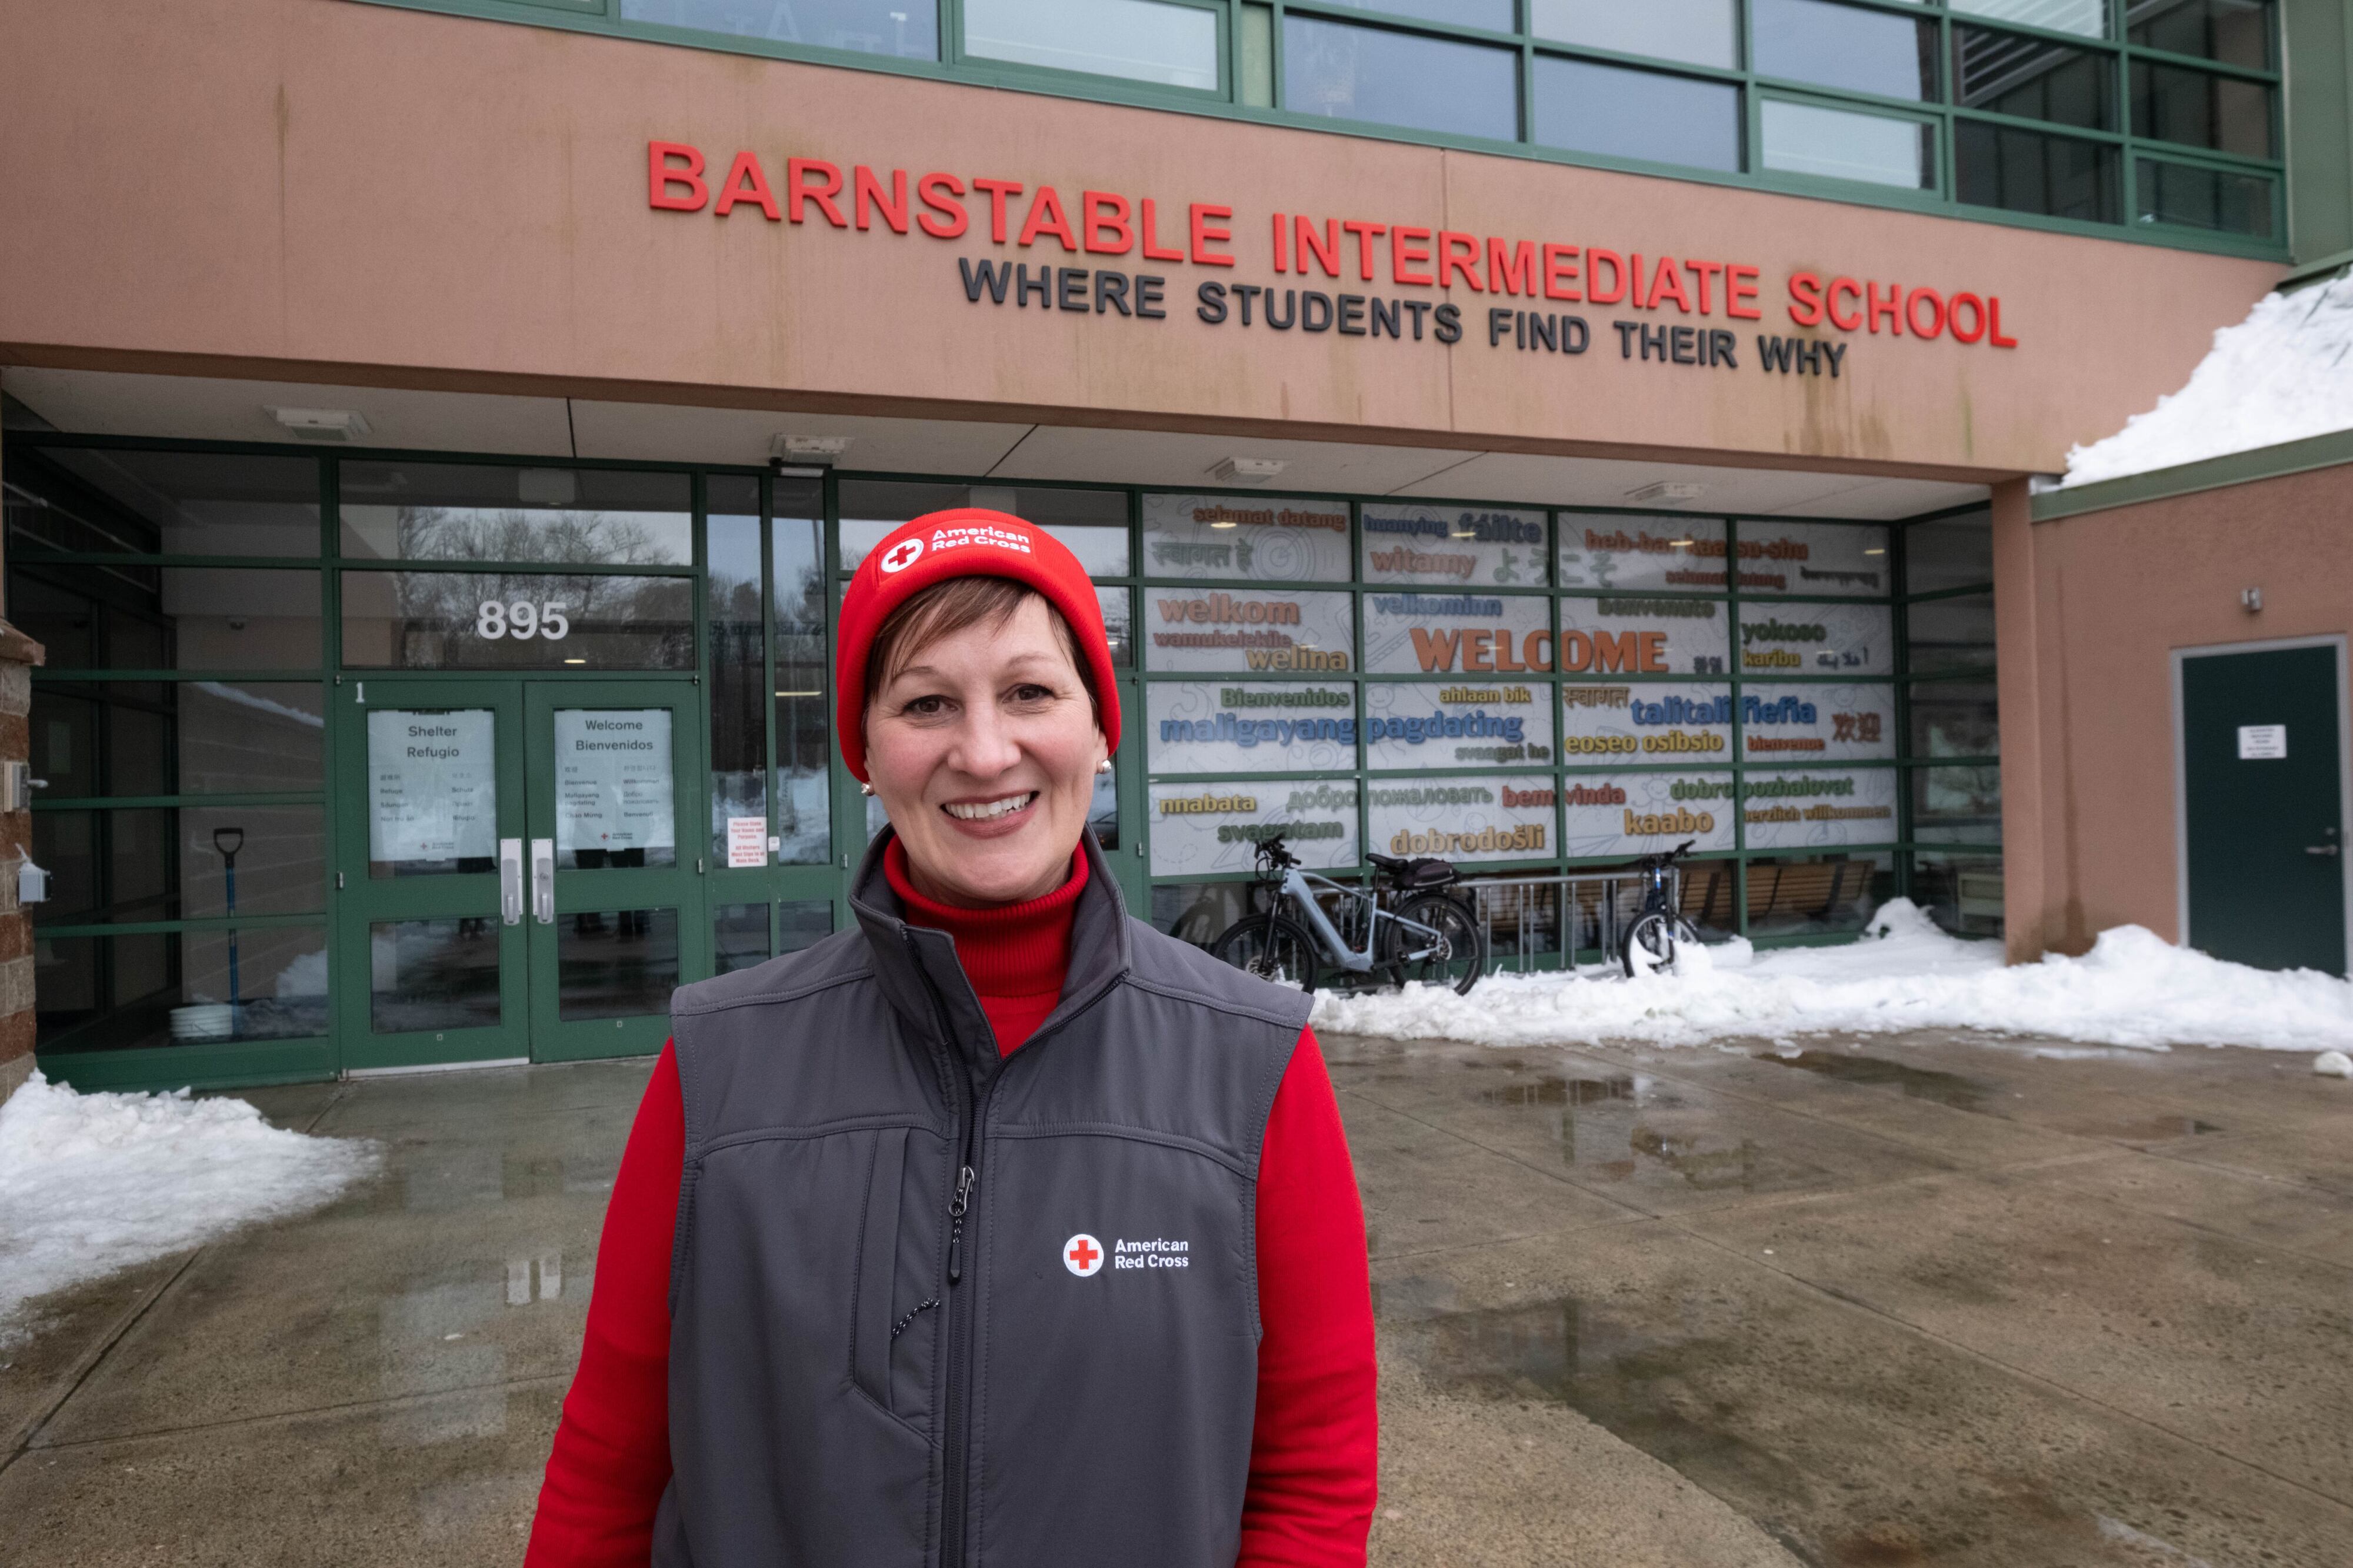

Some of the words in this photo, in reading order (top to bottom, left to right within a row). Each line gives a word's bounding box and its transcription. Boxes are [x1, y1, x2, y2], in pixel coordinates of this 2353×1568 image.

[649, 141, 1235, 262] BARNSTABLE
[1272, 212, 1762, 319] INTERMEDIATE
[1788, 272, 2018, 348] SCHOOL
[959, 257, 1166, 320] WHERE
[1197, 281, 1462, 346] STUDENTS
[1489, 308, 1590, 354] FIND
[1614, 321, 1738, 369] THEIR
[1758, 335, 1847, 378] WHY
[1193, 505, 1274, 523] selamat
[1277, 508, 1346, 532] datang
[931, 535, 970, 552] Red
[974, 535, 1031, 554] Cross
[932, 526, 1030, 544] American
[1370, 546, 1476, 579] witamy
[1157, 593, 1301, 625] welkom
[1373, 594, 1503, 616] velkominn
[476, 600, 569, 640] 895
[1741, 618, 1827, 645] yokoso
[1245, 644, 1349, 671] welina
[1410, 627, 1669, 673] WELCOME
[1743, 649, 1802, 668] karibu
[355, 682, 365, 703] 1
[1220, 688, 1349, 708] Bienvenidos
[1440, 686, 1501, 703] ahlaan
[1504, 686, 1531, 703] bik
[408, 725, 457, 737] Shelter
[585, 720, 643, 730] Welcome
[1160, 713, 1357, 747] maligayang
[1365, 710, 1524, 744] pagdating
[407, 746, 459, 759] Refugio
[575, 740, 653, 751] Bienvenidos
[1565, 734, 1637, 753] eoseo
[1642, 730, 1724, 753] osibsio
[1286, 785, 1358, 813] добро
[1502, 785, 1555, 808] bem
[1565, 782, 1626, 806] vinda
[1669, 779, 1734, 800] dobro
[1160, 793, 1257, 814] nnabata
[1218, 819, 1344, 843] svagatam
[1624, 807, 1715, 836] kaabo
[1390, 824, 1546, 855] dobrodošli
[1115, 1237, 1189, 1253] American
[1115, 1255, 1145, 1269] Red
[1148, 1254, 1189, 1268] Cross
